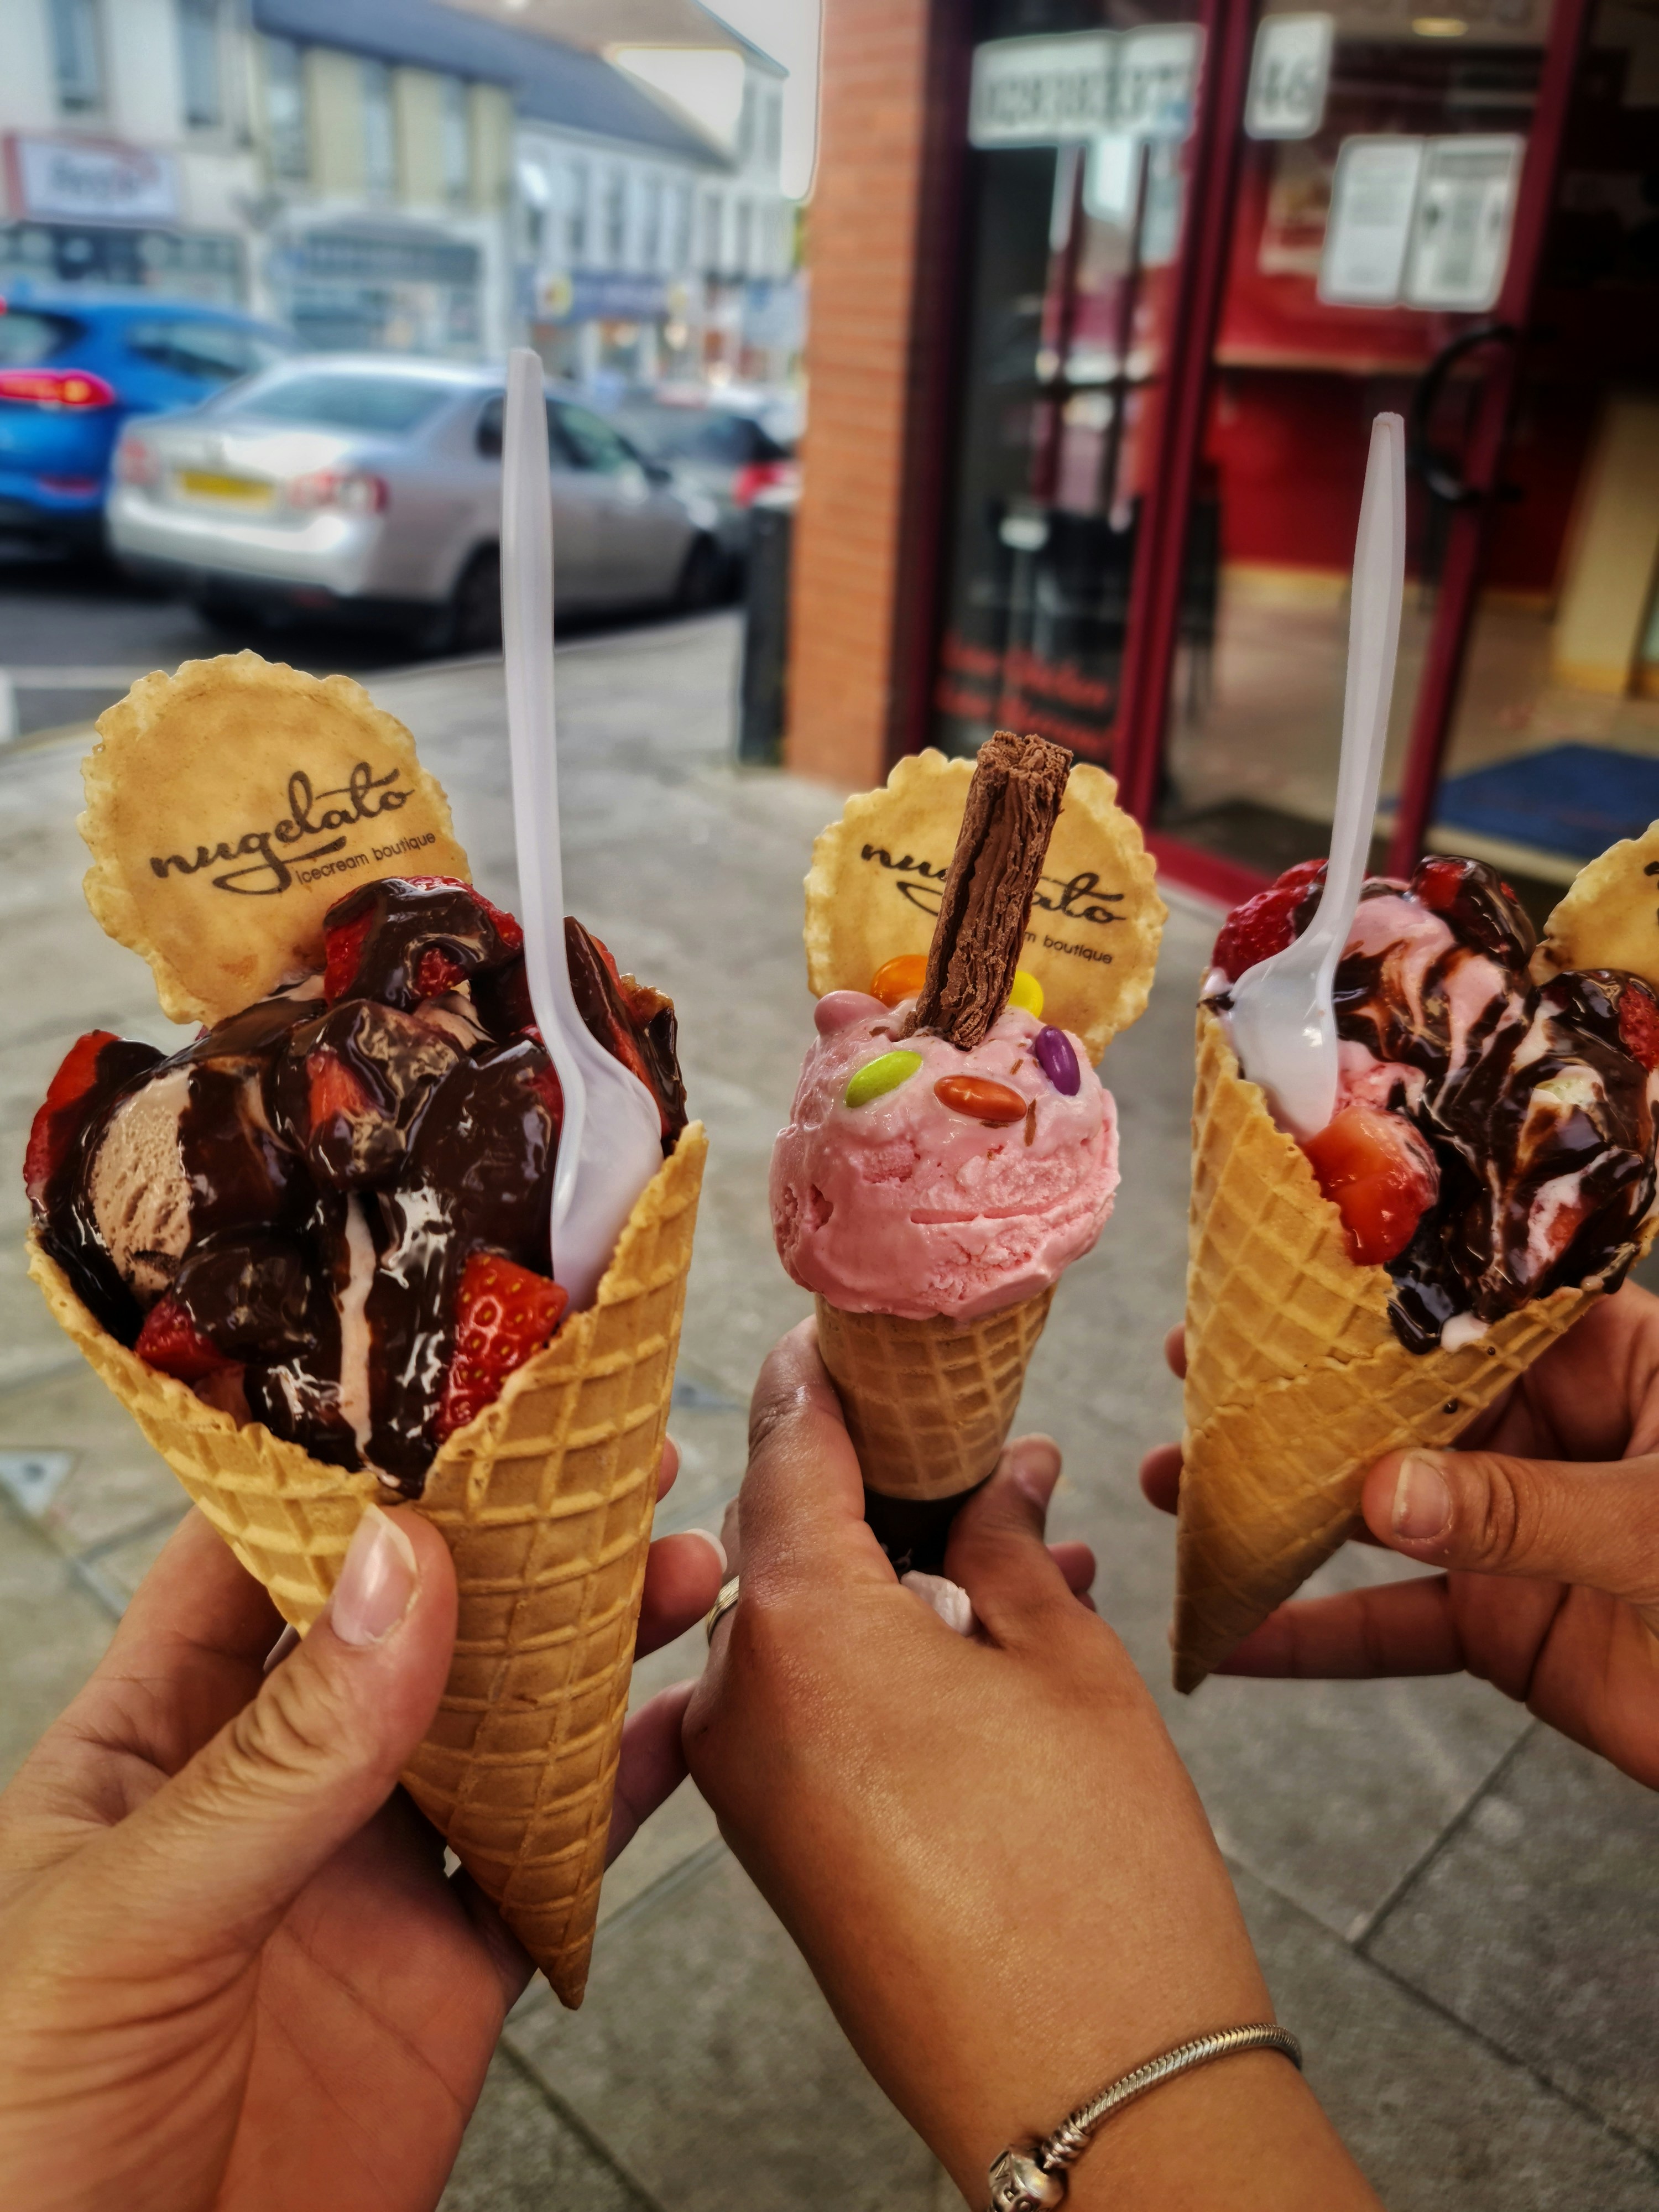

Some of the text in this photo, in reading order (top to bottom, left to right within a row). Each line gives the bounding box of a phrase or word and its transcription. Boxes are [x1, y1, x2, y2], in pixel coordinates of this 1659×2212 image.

[149, 762, 415, 895] nugelato
[296, 832, 436, 885] icecream boutique
[861, 844, 1126, 924] nuato
[1044, 935, 1112, 964] boutique
